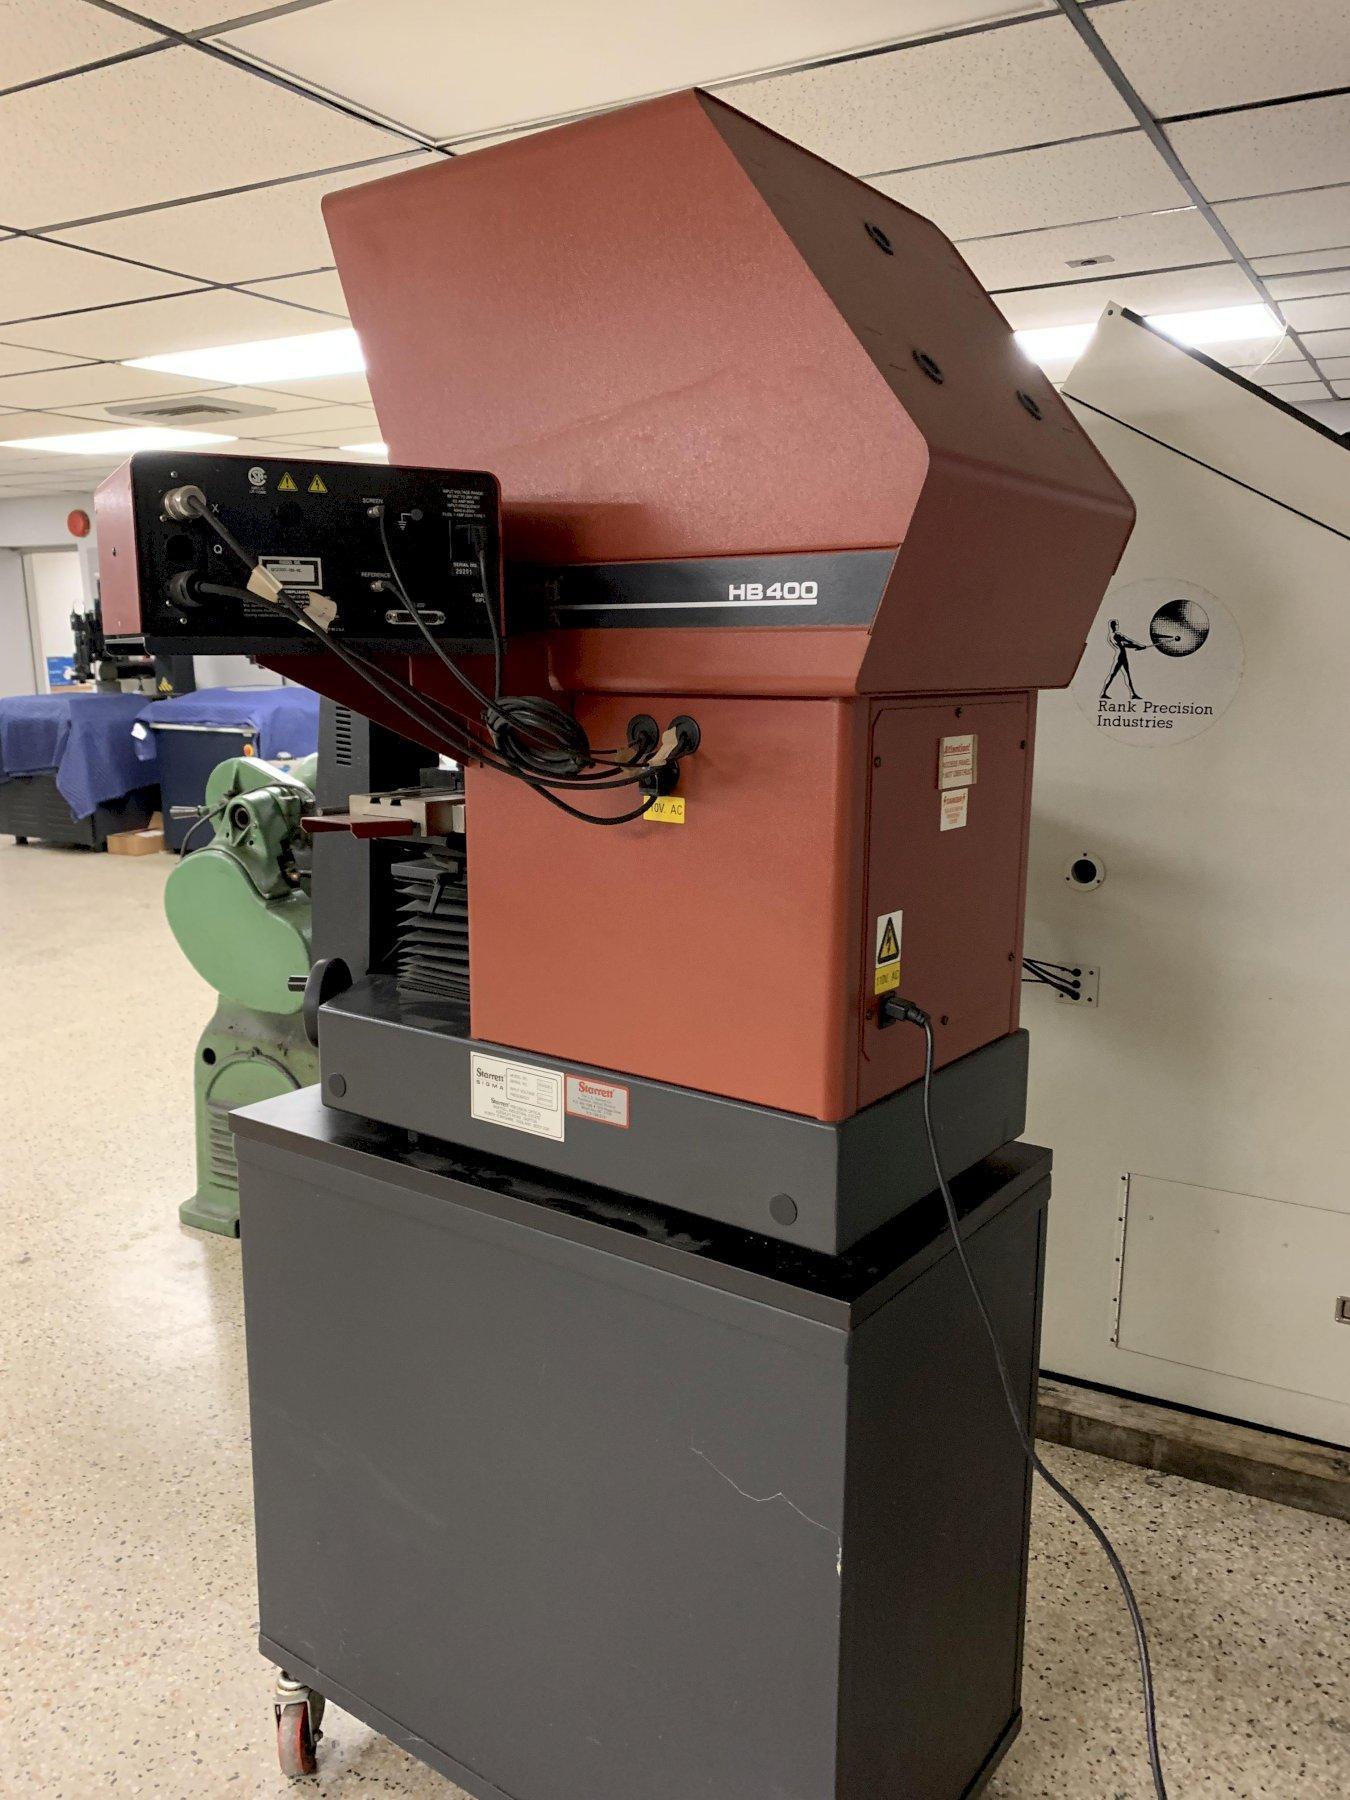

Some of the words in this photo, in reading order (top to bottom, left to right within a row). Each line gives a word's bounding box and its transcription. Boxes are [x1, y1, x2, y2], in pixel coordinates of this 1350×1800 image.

[211, 503, 220, 513] X
[213, 544, 223, 555] Q
[728, 581, 818, 601] HB400
[1097, 700, 1137, 713] Rank
[1142, 701, 1214, 716] Precision
[1096, 715, 1174, 729] Industries
[670, 804, 683, 816] AC
